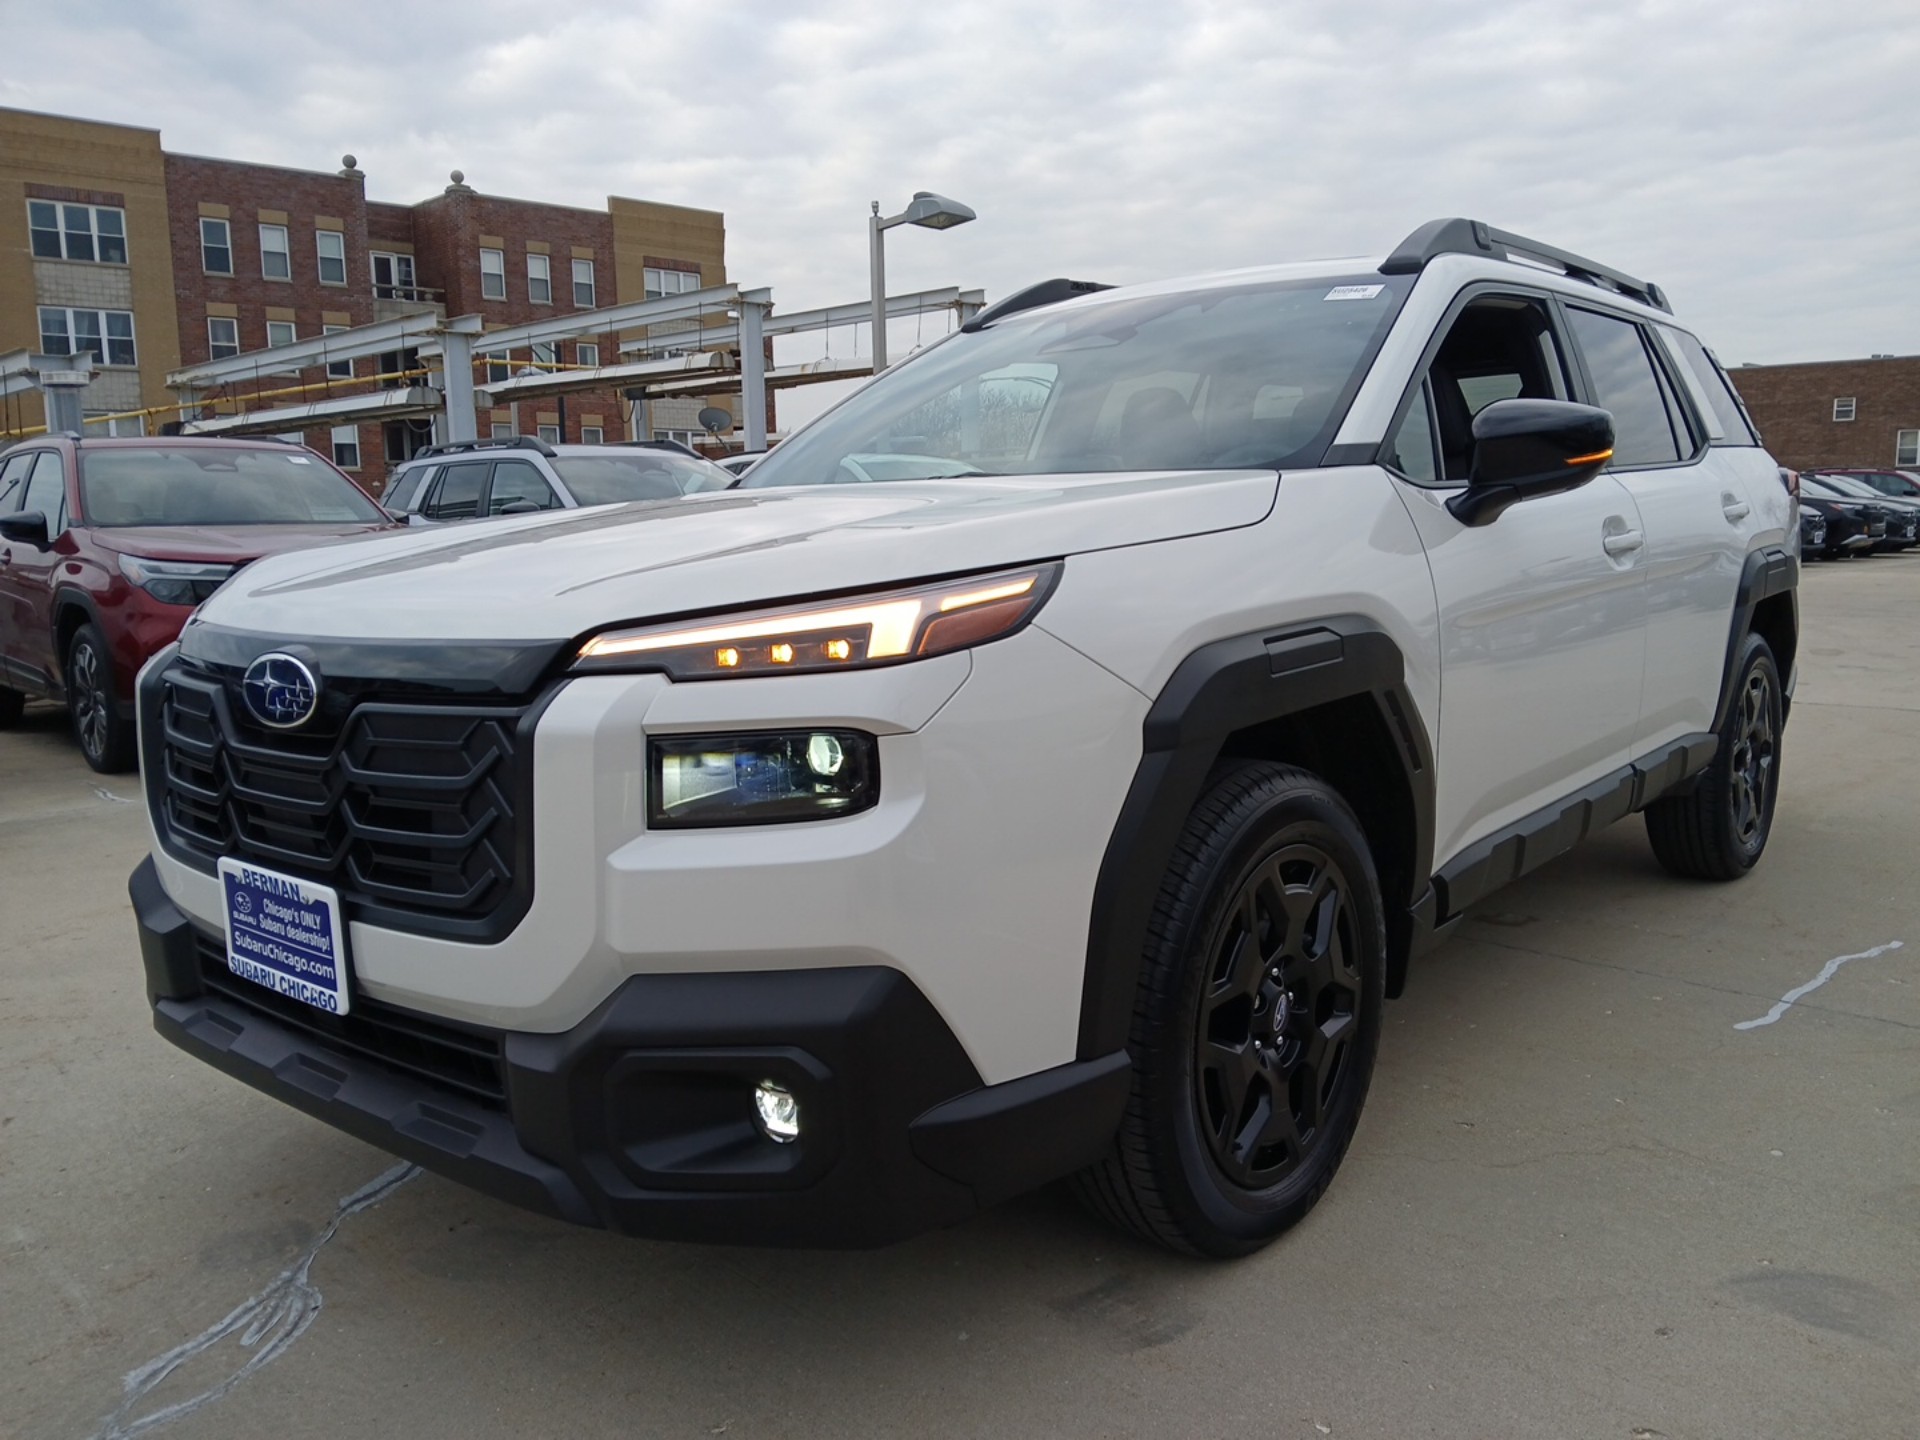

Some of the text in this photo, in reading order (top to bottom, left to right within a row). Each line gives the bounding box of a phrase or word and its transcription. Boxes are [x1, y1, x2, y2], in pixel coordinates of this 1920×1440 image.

[242, 868, 300, 901] BERMAN
[233, 911, 257, 925] SUBARU
[263, 898, 320, 930] Chicago's ONLY
[259, 914, 330, 952] Subaru dealership!
[235, 931, 335, 980] SubaruChicago.com
[230, 956, 337, 1012] SUBARU CHICAGO
